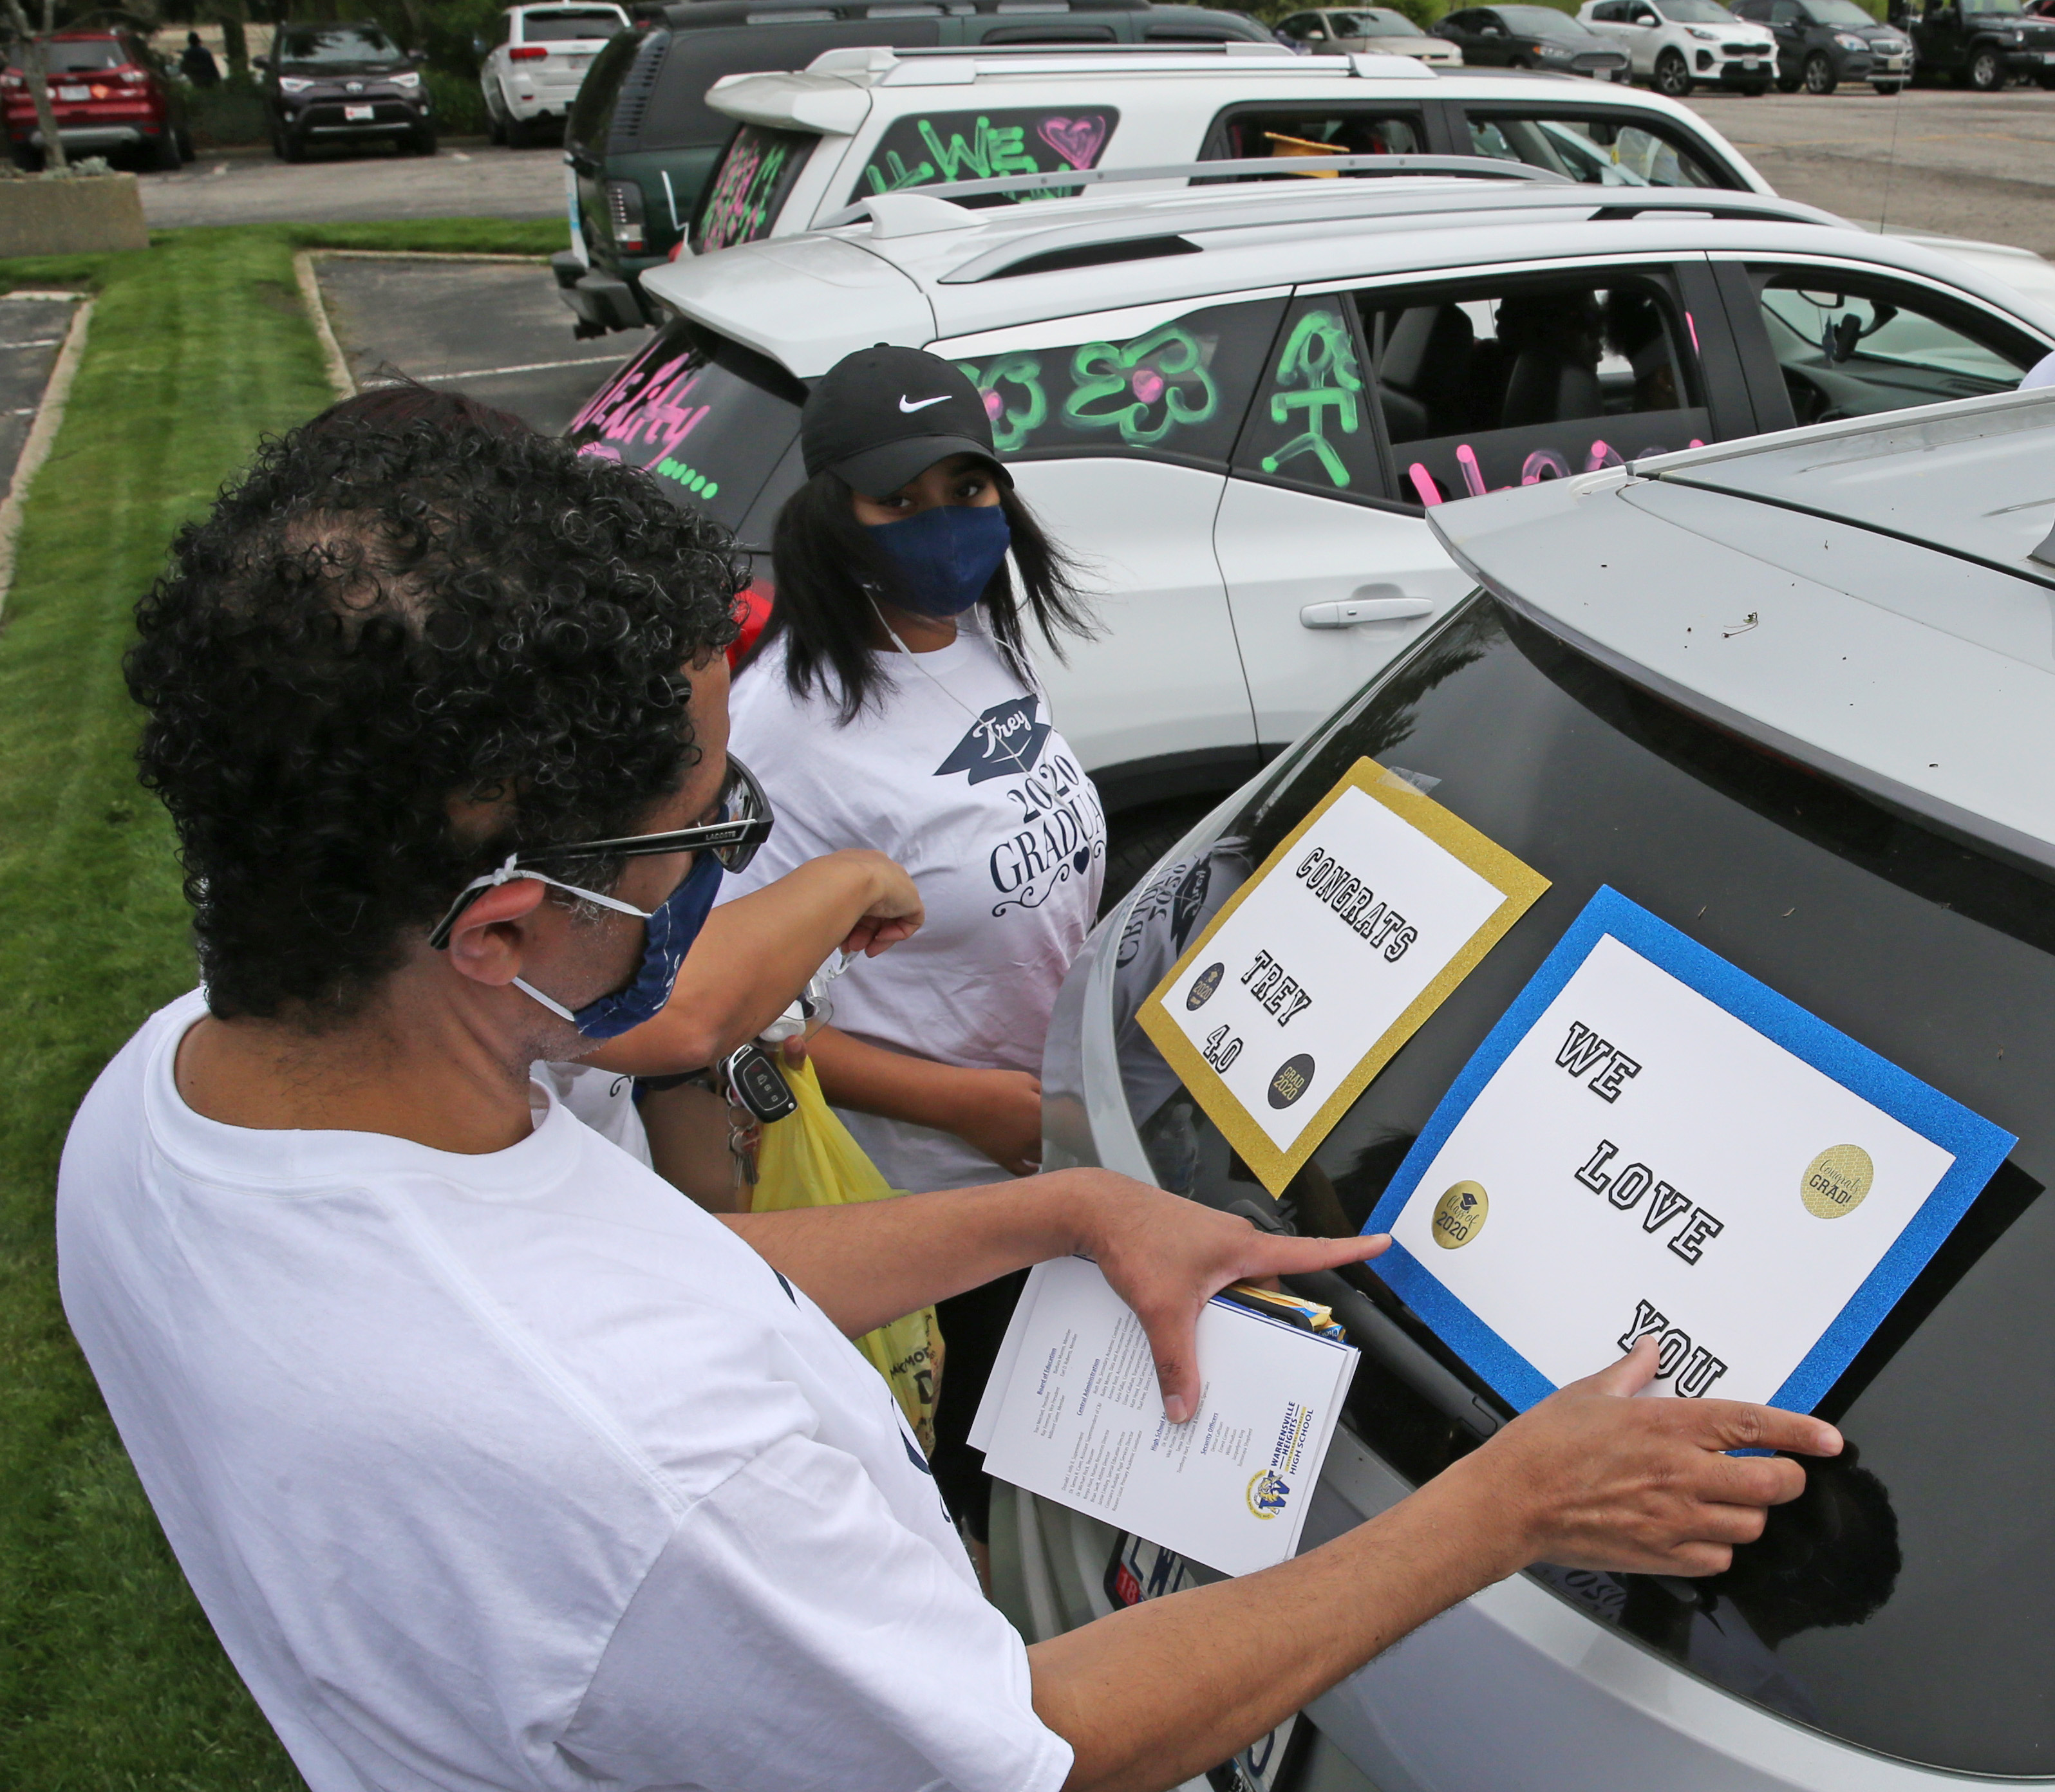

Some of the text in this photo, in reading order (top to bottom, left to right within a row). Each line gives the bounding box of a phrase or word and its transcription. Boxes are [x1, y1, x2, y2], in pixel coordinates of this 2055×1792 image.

[918, 116, 1038, 182] WE
[972, 710, 1032, 758] Trey
[1007, 754, 1078, 824] 2020
[706, 830, 737, 841] LACOSTE
[1296, 847, 1418, 962] CONGRATS
[1193, 980, 1214, 1000] 2020
[1241, 949, 1312, 1027] TREY
[1203, 1024, 1244, 1074] 4.0
[1555, 1021, 1642, 1103] WE
[1273, 1076, 1298, 1101] 2020
[1284, 1066, 1305, 1088] GRAD
[1809, 1174, 1852, 1207] GRAD!
[1819, 1159, 1861, 1194] Congrats
[1447, 1195, 1480, 1229] Class of
[1574, 1139, 1724, 1265] LOVE
[1436, 1211, 1468, 1241] 2020
[1062, 1328, 1072, 1345] Member
[1068, 1333, 1078, 1349] Member
[1105, 1339, 1115, 1357] Academic
[1111, 1317, 1123, 1339] Coordinator
[1617, 1299, 1728, 1398] YOU
[1036, 1379, 1047, 1395] Board
[1043, 1347, 1056, 1372] Education
[1076, 1358, 1100, 1415] Central Administration
[1139, 1361, 1149, 1377] Services
[1041, 1391, 1051, 1408] President
[1051, 1386, 1061, 1404] President
[1056, 1394, 1066, 1410] Member
[1079, 1442, 1089, 1460] Assistant
[1085, 1414, 1099, 1442] Superintendent
[1100, 1428, 1111, 1444] Director
[1120, 1446, 1129, 1461] Services
[1125, 1431, 1134, 1446] Director
[1150, 1437, 1159, 1451] High
[1154, 1420, 1165, 1437] School
[1199, 1412, 1219, 1455] Security Officers
[1270, 1401, 1296, 1467] WARRENSVILLE
[1281, 1418, 1298, 1455] HEIGHTS
[1288, 1408, 1315, 1475] HIGH SCHOOL
[1060, 1477, 1070, 1491] Donald
[1071, 1431, 1085, 1460] Superintendent
[1094, 1444, 1105, 1462] Resources
[1101, 1450, 1111, 1466] Director
[1105, 1464, 1114, 1478] Special
[1110, 1446, 1121, 1464] Education
[1116, 1431, 1126, 1446] Director
[1125, 1451, 1136, 1470] Academic
[1131, 1430, 1143, 1452] Coordinator
[1090, 1462, 1099, 1477] Human
